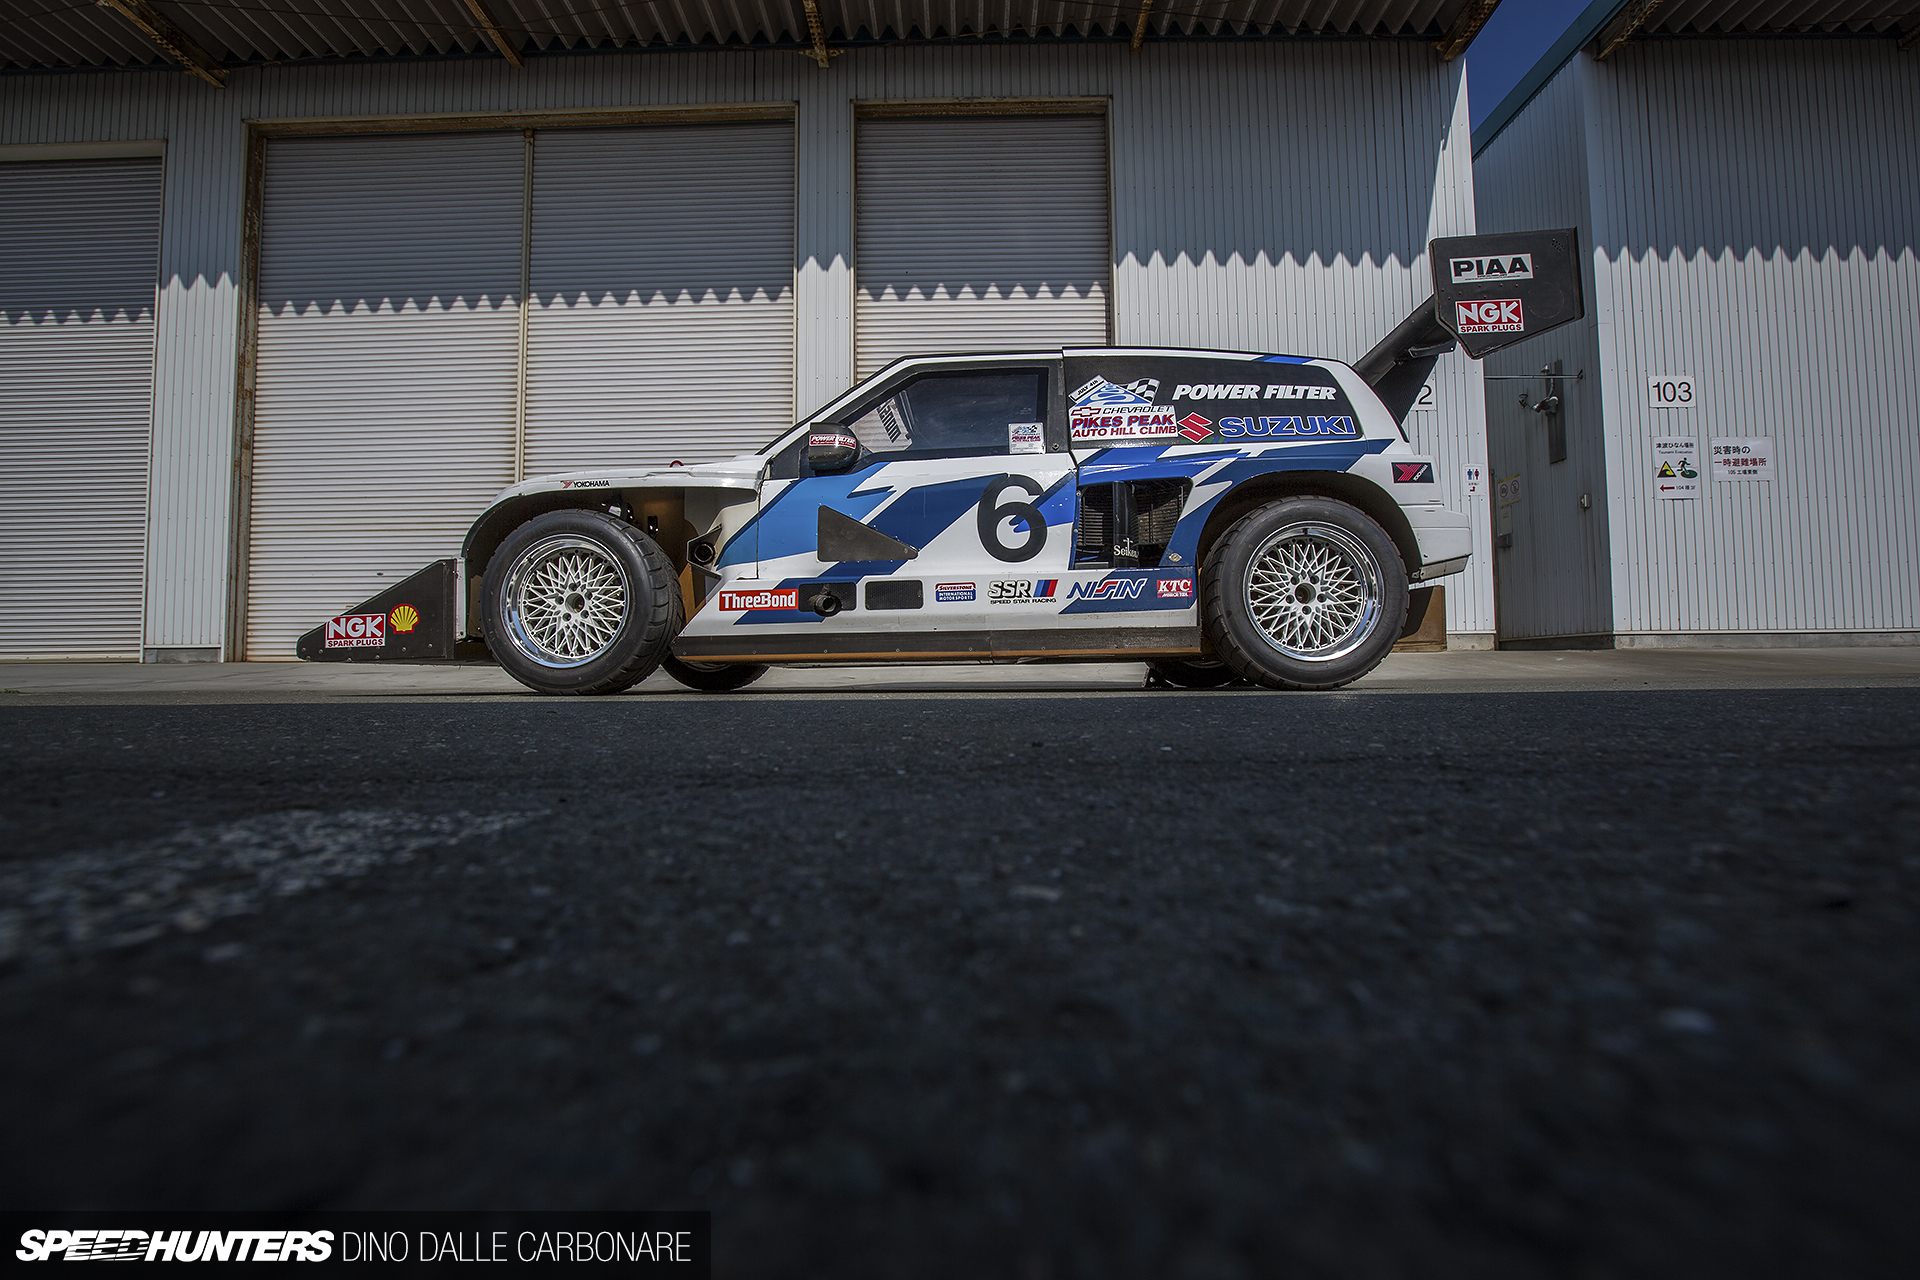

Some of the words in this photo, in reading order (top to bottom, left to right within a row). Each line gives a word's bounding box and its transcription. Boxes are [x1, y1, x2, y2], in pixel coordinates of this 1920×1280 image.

[1453, 257, 1530, 277] PIAA
[1458, 302, 1520, 324] NGK
[1460, 325, 1490, 333] SPARK
[1491, 324, 1522, 332] PLUGS
[1077, 384, 1089, 396] JULY
[1171, 384, 1261, 400] POWER
[1263, 384, 1337, 400] FILTER
[1652, 381, 1693, 402] 103
[1102, 406, 1171, 415] CHEVROLET
[1071, 415, 1124, 430] PIKES
[1126, 413, 1175, 427] PEAK
[1218, 416, 1357, 438] SUZUKI
[1072, 428, 1107, 438] AUTO
[1110, 427, 1136, 436] HILL
[1139, 425, 1177, 435] CLIMB
[1713, 445, 1751, 455] 災害時の
[1713, 457, 1767, 467] 一時避難場所
[573, 480, 610, 488] YOKOHAMA
[977, 473, 1047, 563] 6
[987, 580, 1032, 598] SSR
[1158, 579, 1192, 592] KTC
[721, 591, 797, 609] ThreeBond
[328, 616, 383, 638] NGK
[356, 638, 383, 646] PLUGS
